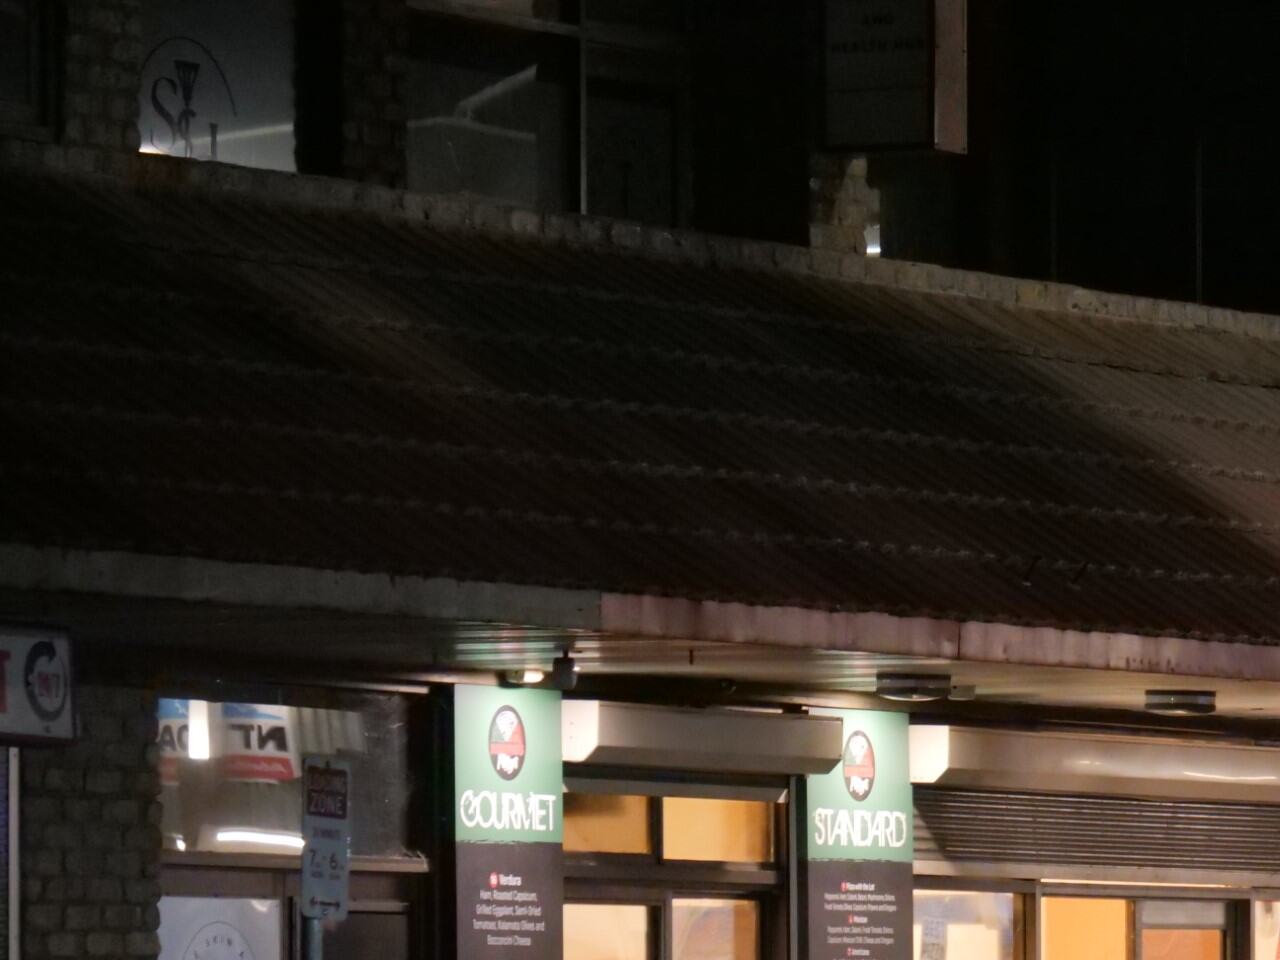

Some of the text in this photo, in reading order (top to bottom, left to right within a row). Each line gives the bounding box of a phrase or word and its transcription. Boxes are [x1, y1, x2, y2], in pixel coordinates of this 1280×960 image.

[309, 792, 345, 816] ZONE
[460, 790, 556, 833] GOURMET
[814, 807, 908, 849] STANDARD
